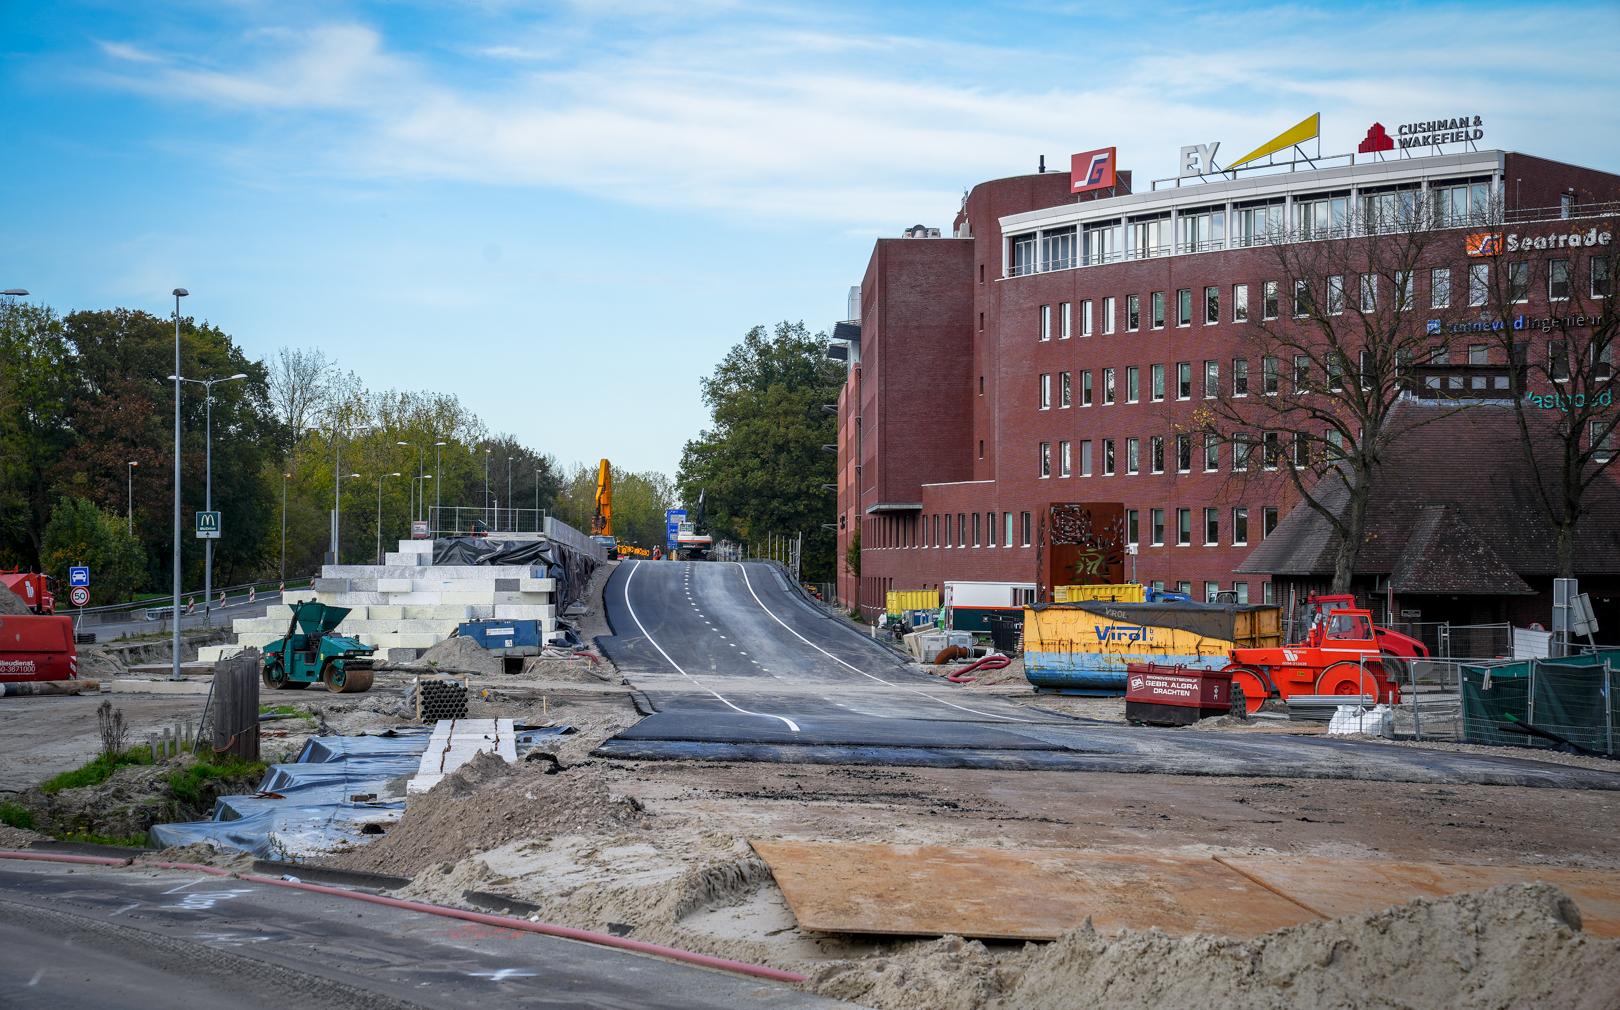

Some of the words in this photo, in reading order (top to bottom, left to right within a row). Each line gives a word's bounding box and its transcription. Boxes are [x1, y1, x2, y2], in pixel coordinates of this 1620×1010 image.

[1397, 117, 1470, 136] CUSHMAN
[1472, 115, 1483, 127] &
[1397, 129, 1484, 149] WAKEFIELD
[1180, 141, 1221, 177] EY
[1507, 228, 1612, 252] Seatrade
[74, 592, 86, 601] 50
[1095, 625, 1147, 641] Virol
[0, 665, 36, 673] 0-3871000
[1145, 680, 1169, 688] GEBR.
[1170, 682, 1199, 690] ALGRA
[1153, 687, 1190, 697] DRACHTEN
